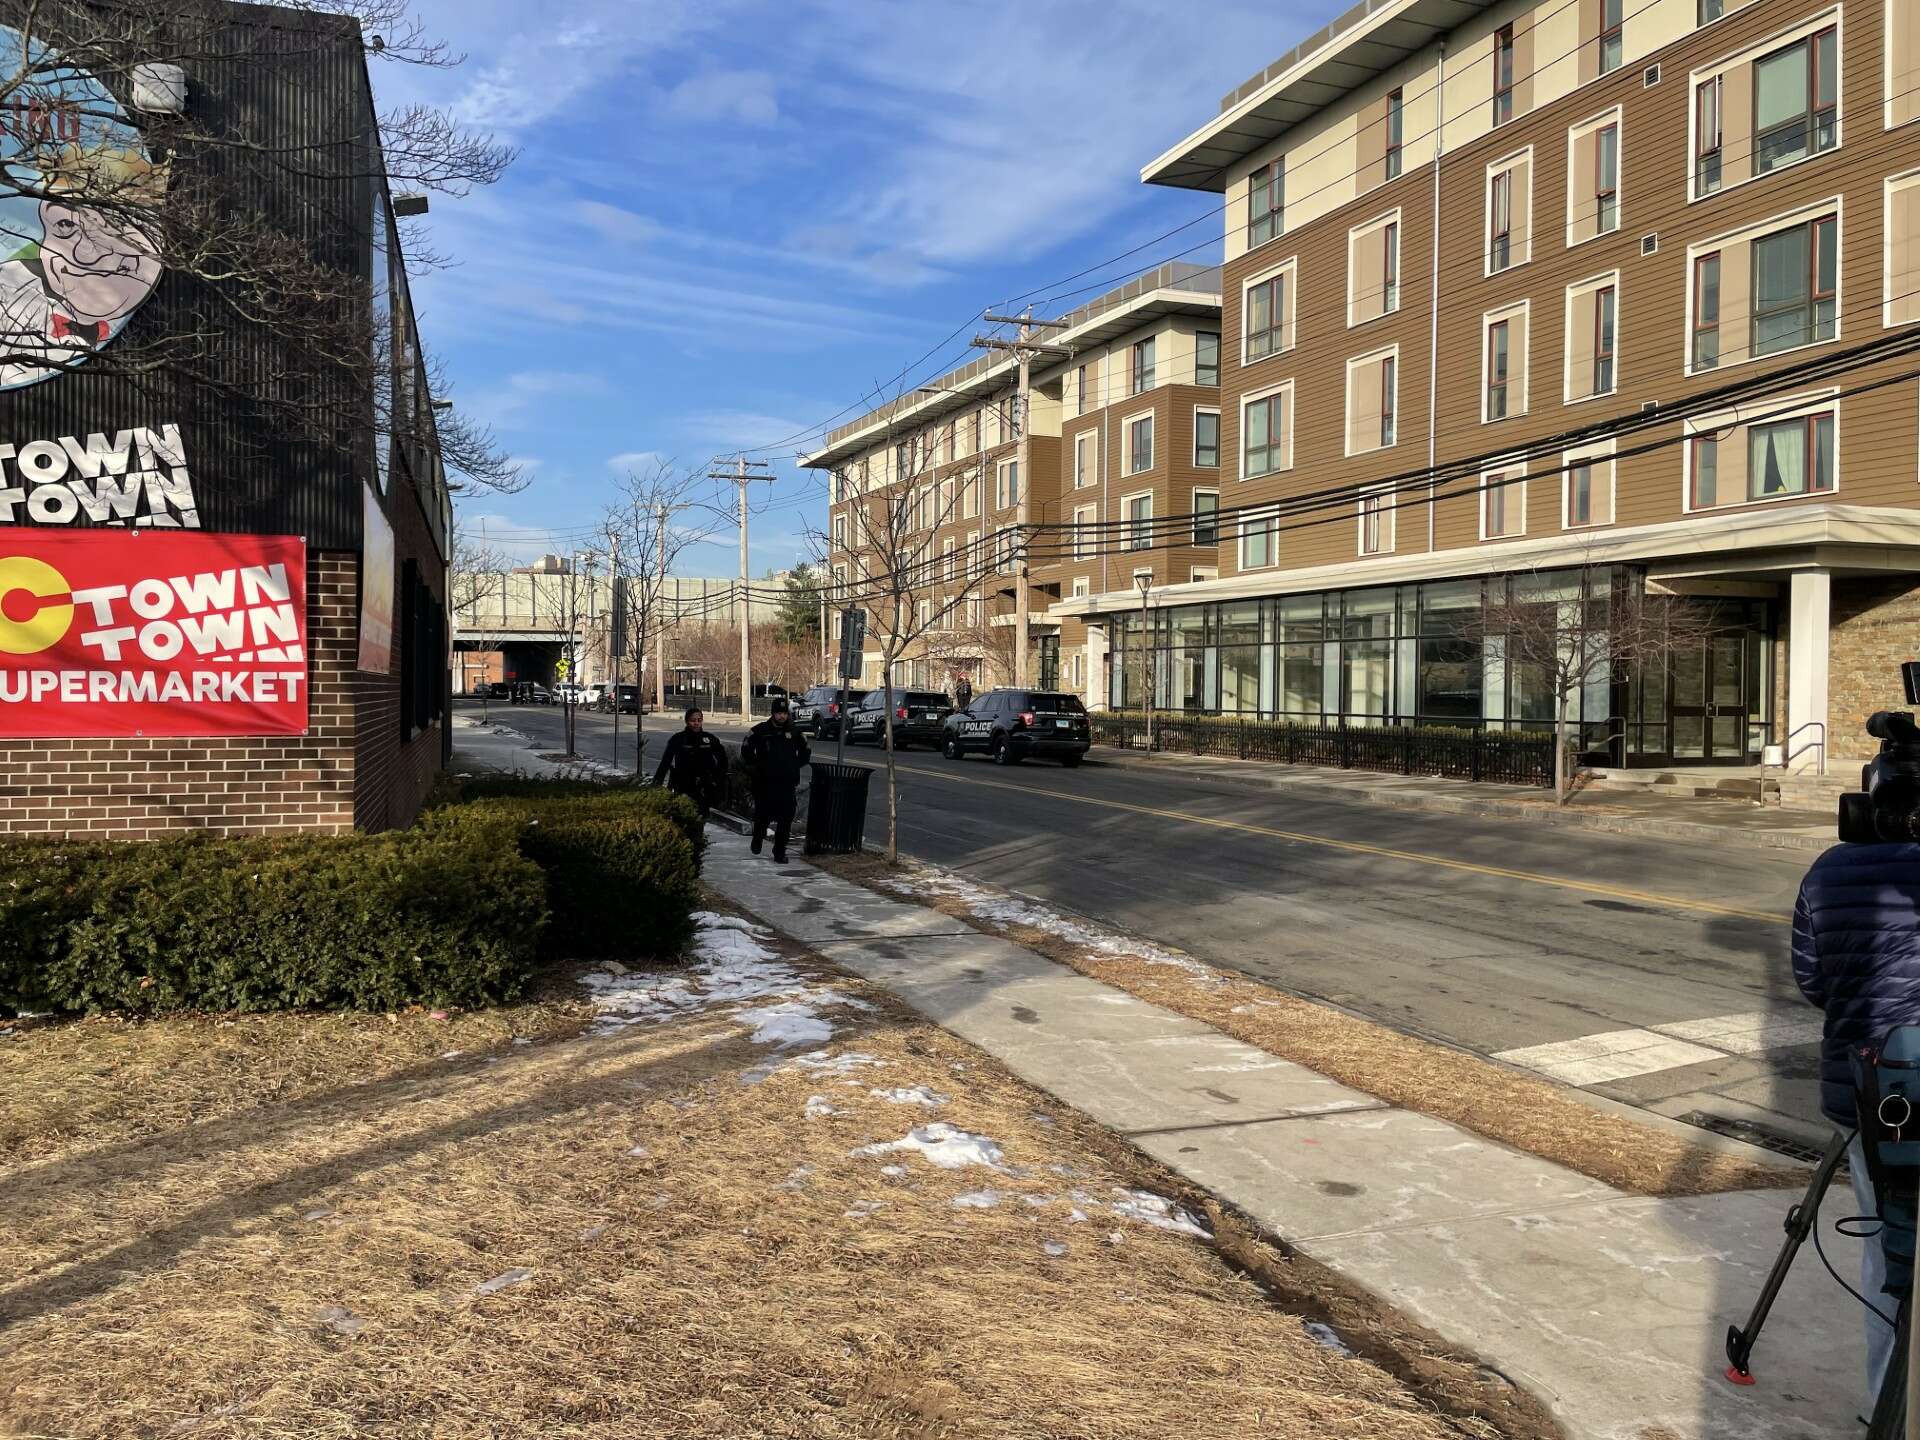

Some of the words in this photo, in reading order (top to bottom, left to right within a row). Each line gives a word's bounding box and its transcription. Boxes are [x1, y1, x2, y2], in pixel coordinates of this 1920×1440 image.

[0, 424, 187, 488] OWN
[81, 604, 299, 661] TOWN
[857, 713, 876, 723] POLICE
[965, 722, 993, 732] POLICE
